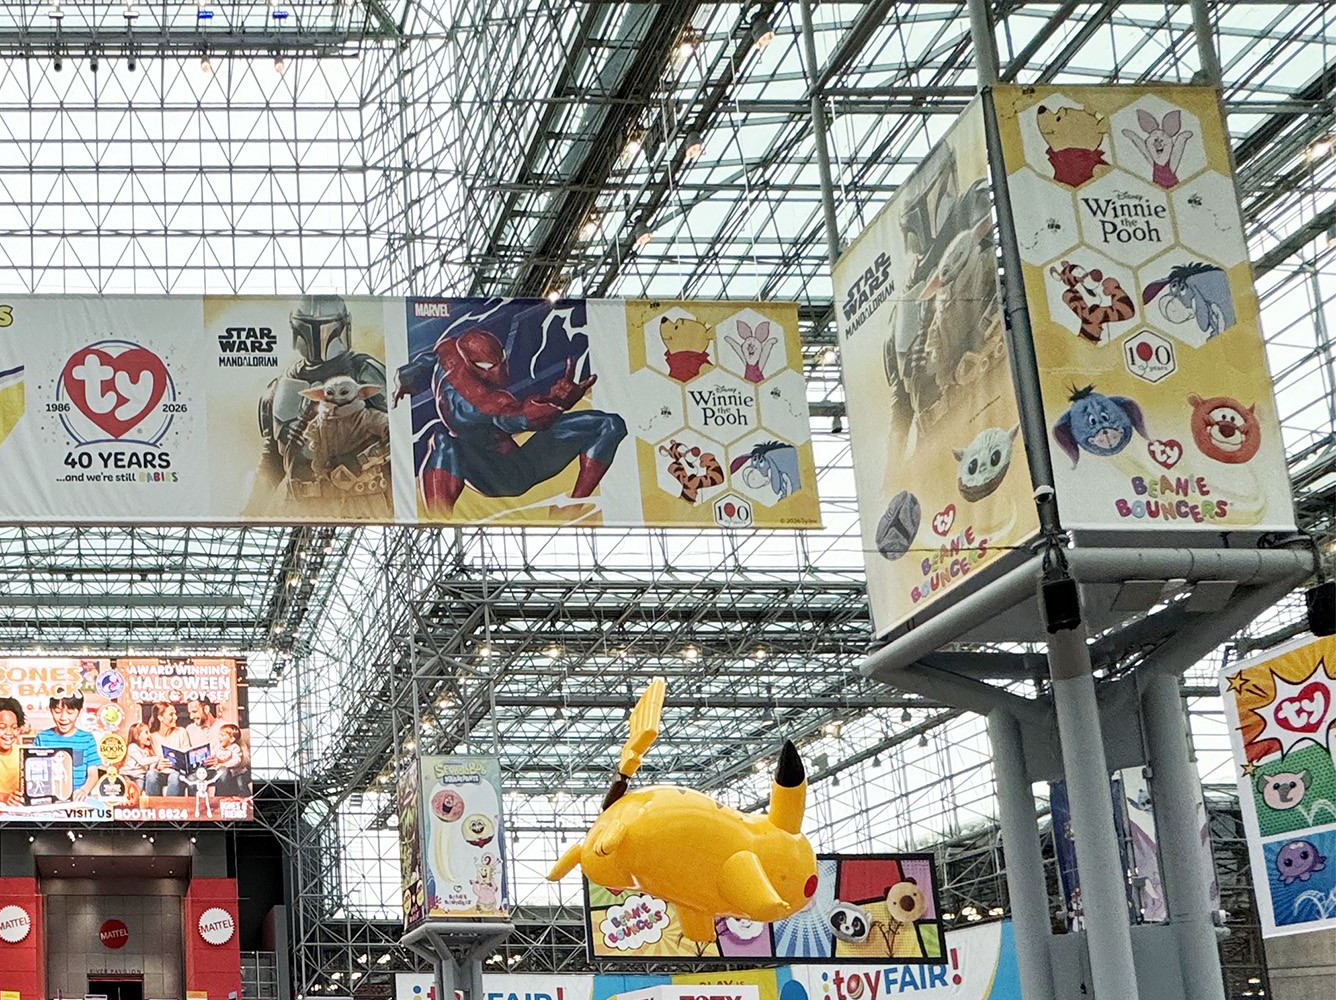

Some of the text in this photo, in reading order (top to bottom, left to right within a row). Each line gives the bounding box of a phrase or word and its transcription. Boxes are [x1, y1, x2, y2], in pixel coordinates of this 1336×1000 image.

[1082, 197, 1166, 219] Winnie
[1120, 218, 1138, 227] the
[1099, 219, 1162, 244] Pooh
[843, 252, 891, 309] STAR
[844, 261, 892, 322] WARS
[414, 303, 450, 317] MARVEL
[845, 280, 895, 340] MANDALORIAN
[218, 328, 277, 340] STAR
[218, 340, 277, 353] WARS
[219, 357, 278, 367] MANDALORIAN
[72, 354, 154, 422] ty
[46, 403, 71, 412] 1986
[688, 390, 754, 408] Winnie
[162, 403, 188, 413] 2026
[717, 406, 731, 415] the
[701, 407, 748, 427] Pooh
[64, 452, 171, 469] 40 YEARS
[1150, 442, 1179, 464] ty
[86, 472, 113, 482] we're
[115, 472, 136, 482] still
[139, 472, 179, 483] BABIES
[1131, 474, 1210, 498] BEANIE
[1115, 499, 1228, 523] BOUNCERS
[934, 510, 954, 534] ty
[921, 525, 975, 577] BEANIE
[911, 538, 988, 603] BOUNCERS
[129, 665, 230, 675] AWARD WINNING
[18, 684, 83, 698] BACK
[130, 676, 231, 690] HALLOWEEN
[131, 690, 165, 700] BOOK
[183, 690, 208, 701] TOY
[209, 690, 231, 700] SET
[1278, 693, 1327, 729] ty
[64, 808, 156, 820] VISIT US BOOTH
[611, 902, 651, 929] BEANIE
[100, 928, 128, 940] MATTEL
[201, 919, 234, 934] MATTEL
[608, 910, 663, 943] BOUNCERS
